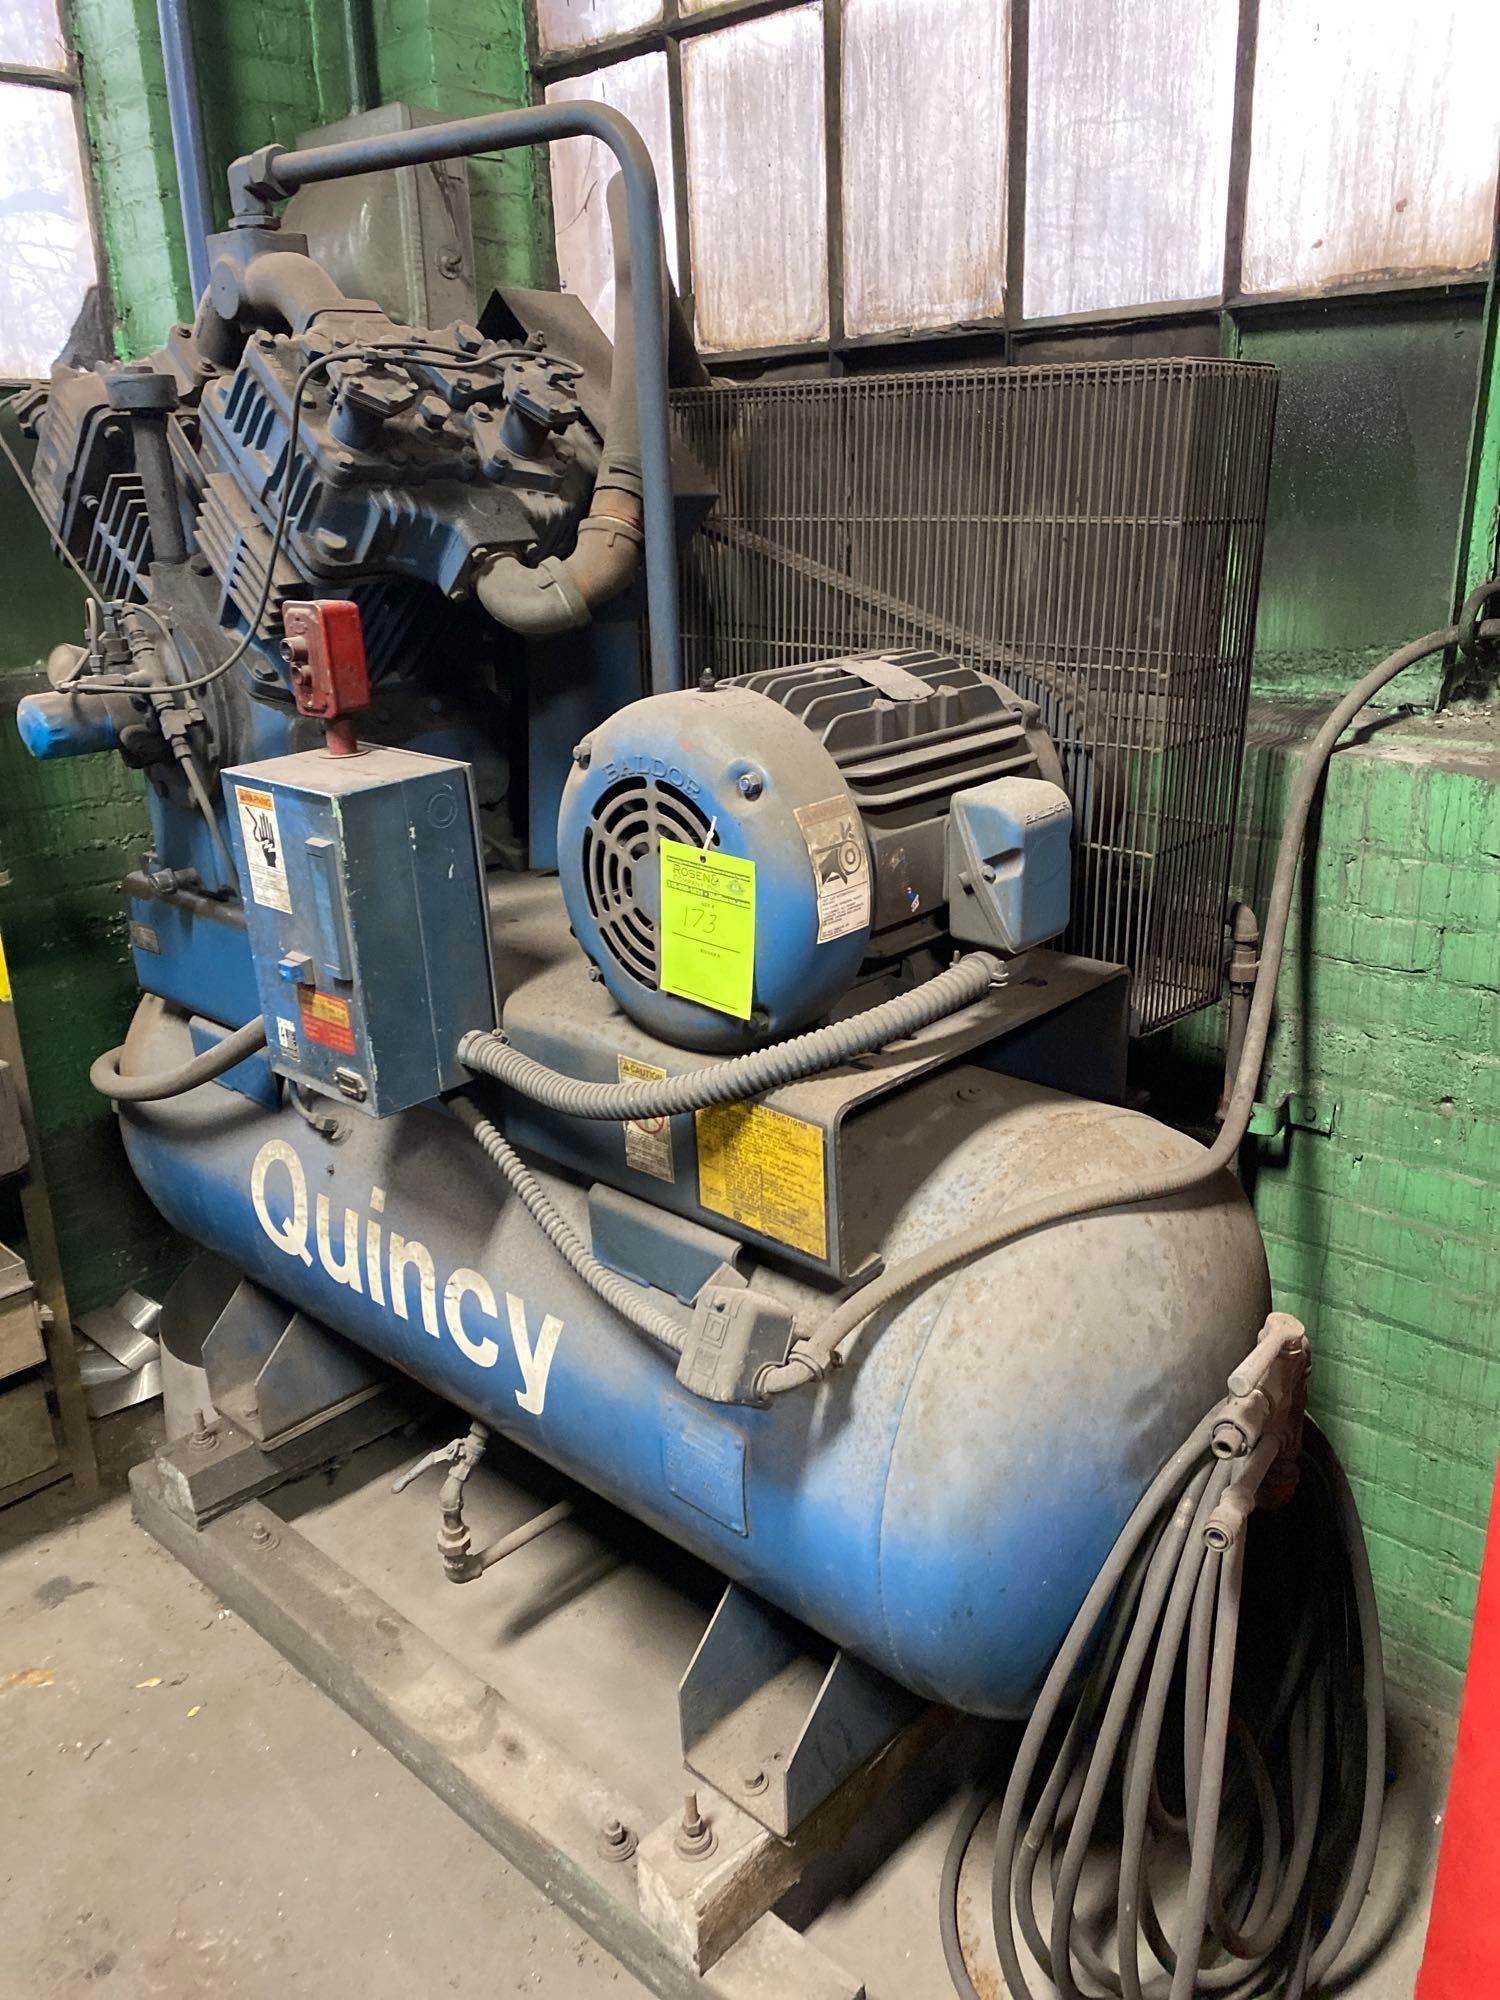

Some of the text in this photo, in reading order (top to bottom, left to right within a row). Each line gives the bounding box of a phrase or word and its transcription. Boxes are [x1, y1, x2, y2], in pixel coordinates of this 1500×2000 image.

[602, 755, 701, 800] BALDOR
[673, 863, 710, 883] ROSEN
[684, 906, 717, 933] 173
[630, 1064, 663, 1081] CAUTION
[251, 1139, 564, 1415] Quincy
